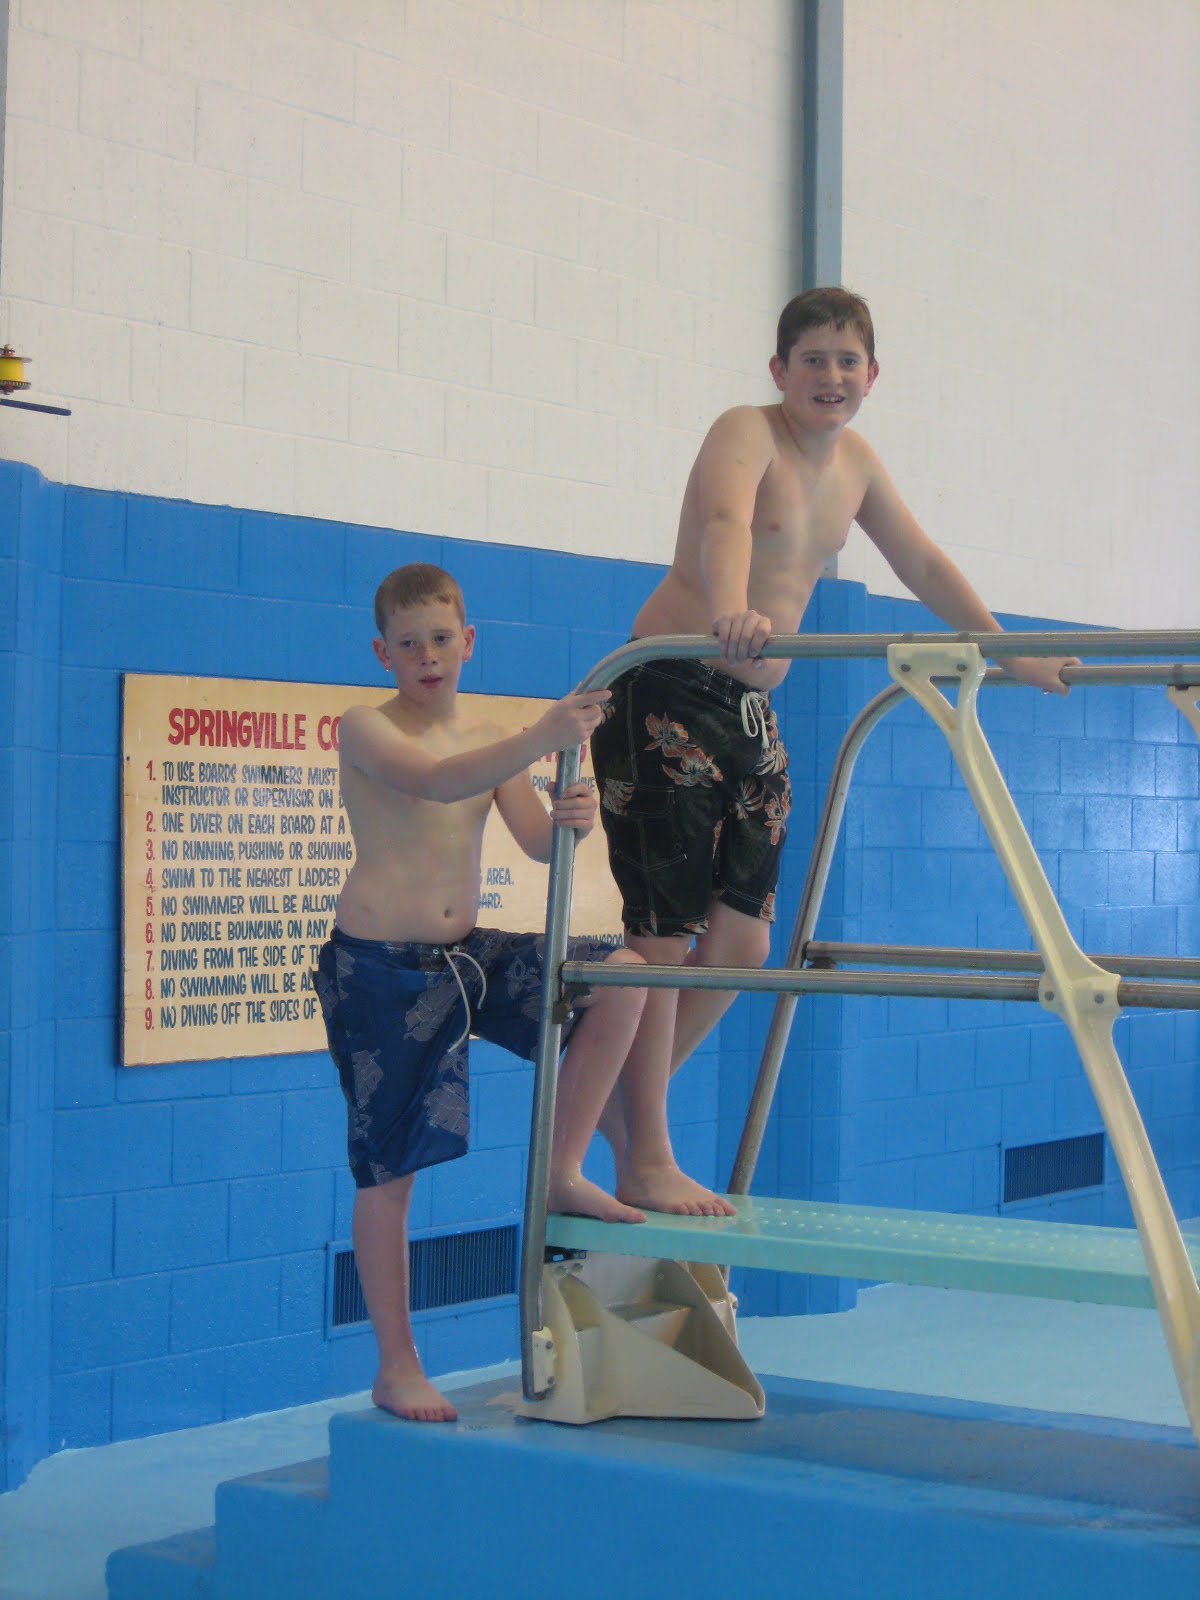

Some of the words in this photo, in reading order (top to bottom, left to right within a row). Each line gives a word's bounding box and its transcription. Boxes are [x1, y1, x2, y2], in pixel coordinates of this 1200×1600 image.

[168, 708, 306, 750] SPRINGVILLE
[146, 760, 156, 780] 1.
[162, 761, 174, 781] TO
[177, 761, 195, 782] USE
[199, 762, 237, 783] BOARDS
[242, 764, 302, 785] SWIMMERS
[308, 767, 337, 786] MUST
[162, 785, 230, 806] INSTRUCTOR
[234, 787, 249, 807] OR
[252, 787, 314, 808] SUPERVISOR
[319, 789, 333, 808] ON
[146, 811, 156, 832] 2.
[162, 812, 184, 833] ONE
[190, 812, 223, 834] DIVER
[228, 813, 243, 834] ON
[248, 814, 275, 834] EACH
[280, 815, 316, 835] BOARD
[320, 816, 334, 834] AT
[337, 816, 346, 834] A
[162, 840, 178, 860] NO
[239, 841, 285, 860] PUSHING
[289, 841, 303, 860] OR
[307, 841, 353, 860] SHOVING
[162, 868, 195, 888] SWIM
[200, 868, 215, 888] TO
[218, 868, 242, 888] THE
[246, 868, 293, 888] NEAREST
[298, 867, 340, 887] LADDER
[146, 896, 155, 916] 5.
[161, 896, 177, 916] NO
[182, 896, 245, 916] SWIMMER
[249, 895, 279, 914] WILL
[282, 895, 297, 914] BE
[302, 893, 340, 913] ALLOW
[145, 922, 155, 944] 6.
[161, 922, 176, 943] NO
[181, 921, 222, 942] DOUBLE
[227, 920, 284, 941] BOUNCING
[287, 919, 302, 939] ON
[306, 918, 329, 939] ANY
[161, 947, 198, 971] DIVING
[204, 946, 234, 969] FROM
[237, 946, 259, 968] THE
[262, 945, 287, 967] SIDE
[292, 944, 306, 965] OF
[145, 978, 155, 1000] 8.
[161, 978, 176, 999] NO
[180, 974, 247, 998] SWIMMING
[250, 973, 279, 994] WILL
[283, 972, 297, 993] BE
[144, 1007, 155, 1030] 9.
[161, 1006, 176, 1029] NO
[181, 1003, 218, 1028] DIVING
[221, 1002, 241, 1025] OFF
[245, 1001, 266, 1024] THE
[269, 999, 300, 1022] SIDES
[303, 998, 317, 1020] OF
